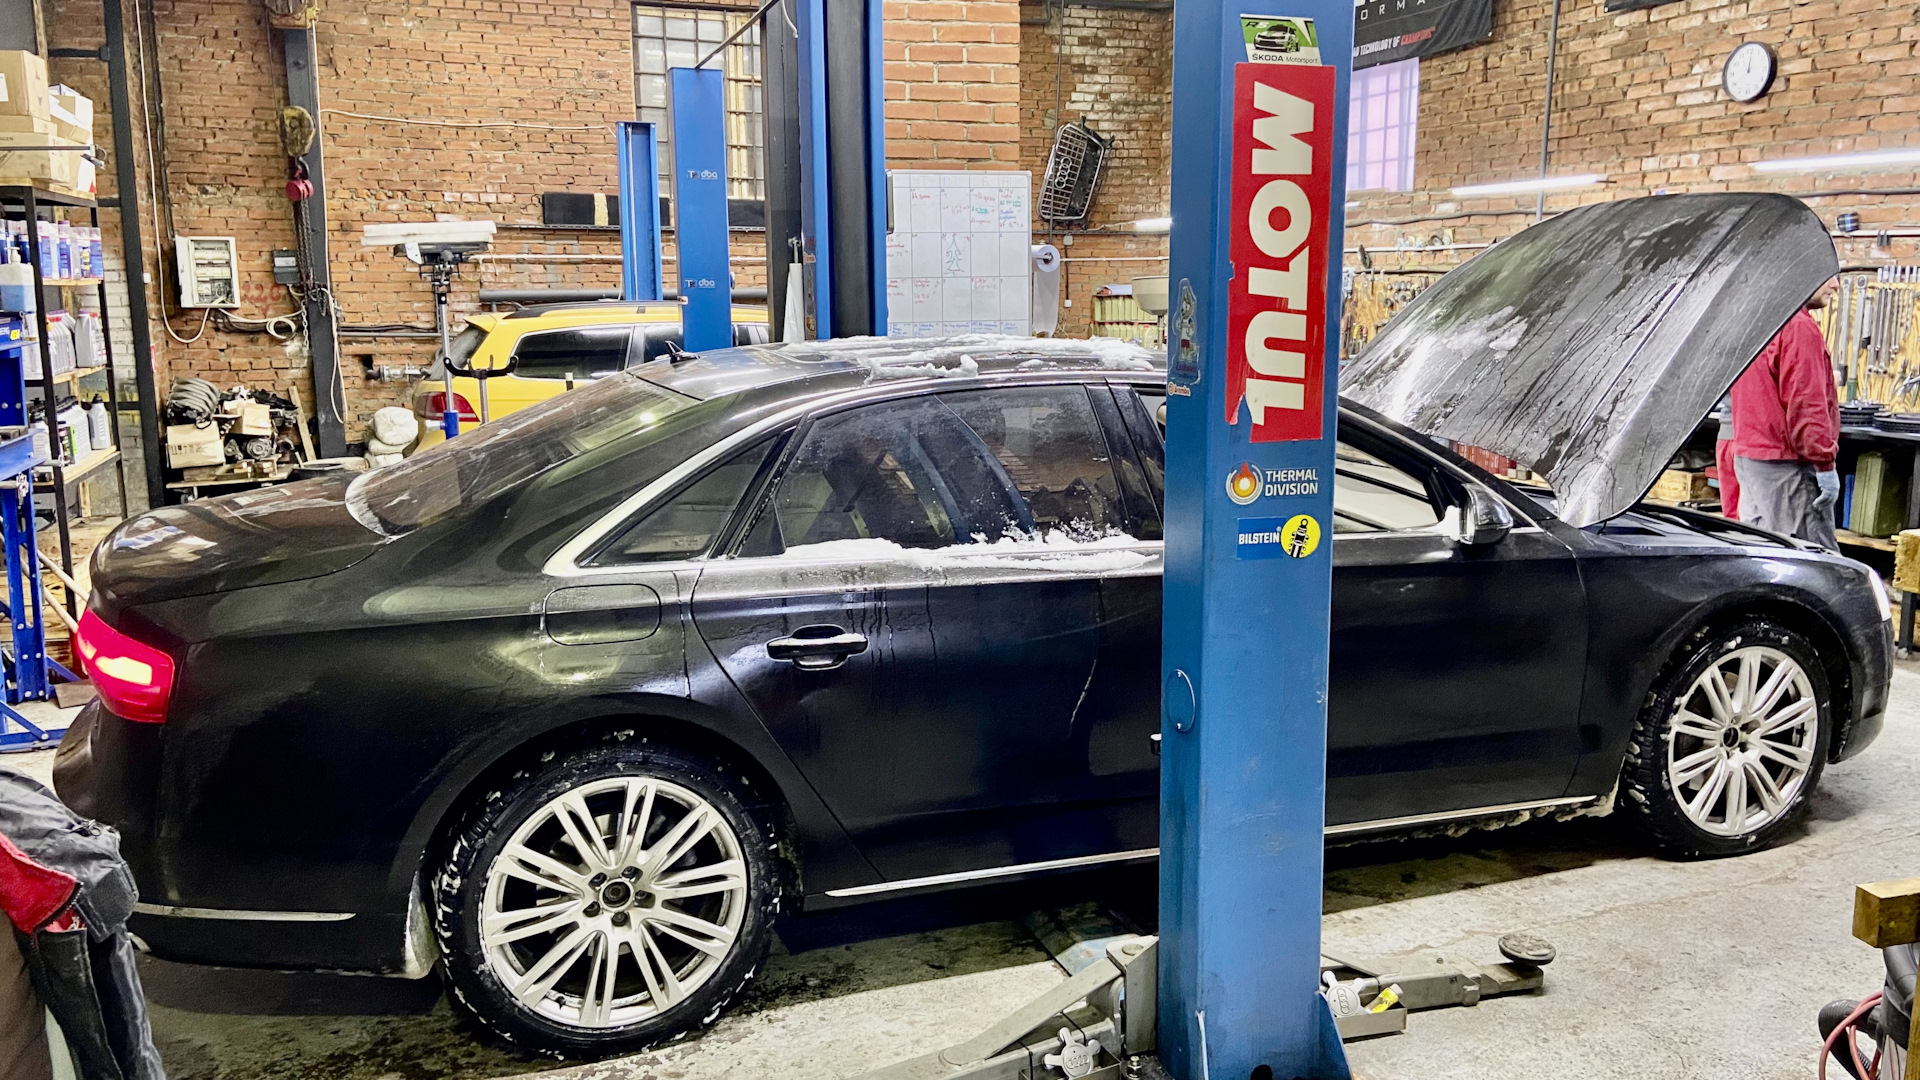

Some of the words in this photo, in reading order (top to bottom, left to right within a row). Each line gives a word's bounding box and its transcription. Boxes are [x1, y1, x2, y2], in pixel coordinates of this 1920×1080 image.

[1360, 38, 1393, 56] TECHNOLOGY
[1392, 35, 1401, 48] OF
[1252, 53, 1284, 62] ŠKODA
[1286, 56, 1319, 64] Motorsport
[1245, 81, 1315, 426] MOTUL
[1266, 469, 1318, 482] THERMAL
[1265, 482, 1318, 496] DIVISION
[1238, 532, 1281, 545] BILSTEIN
